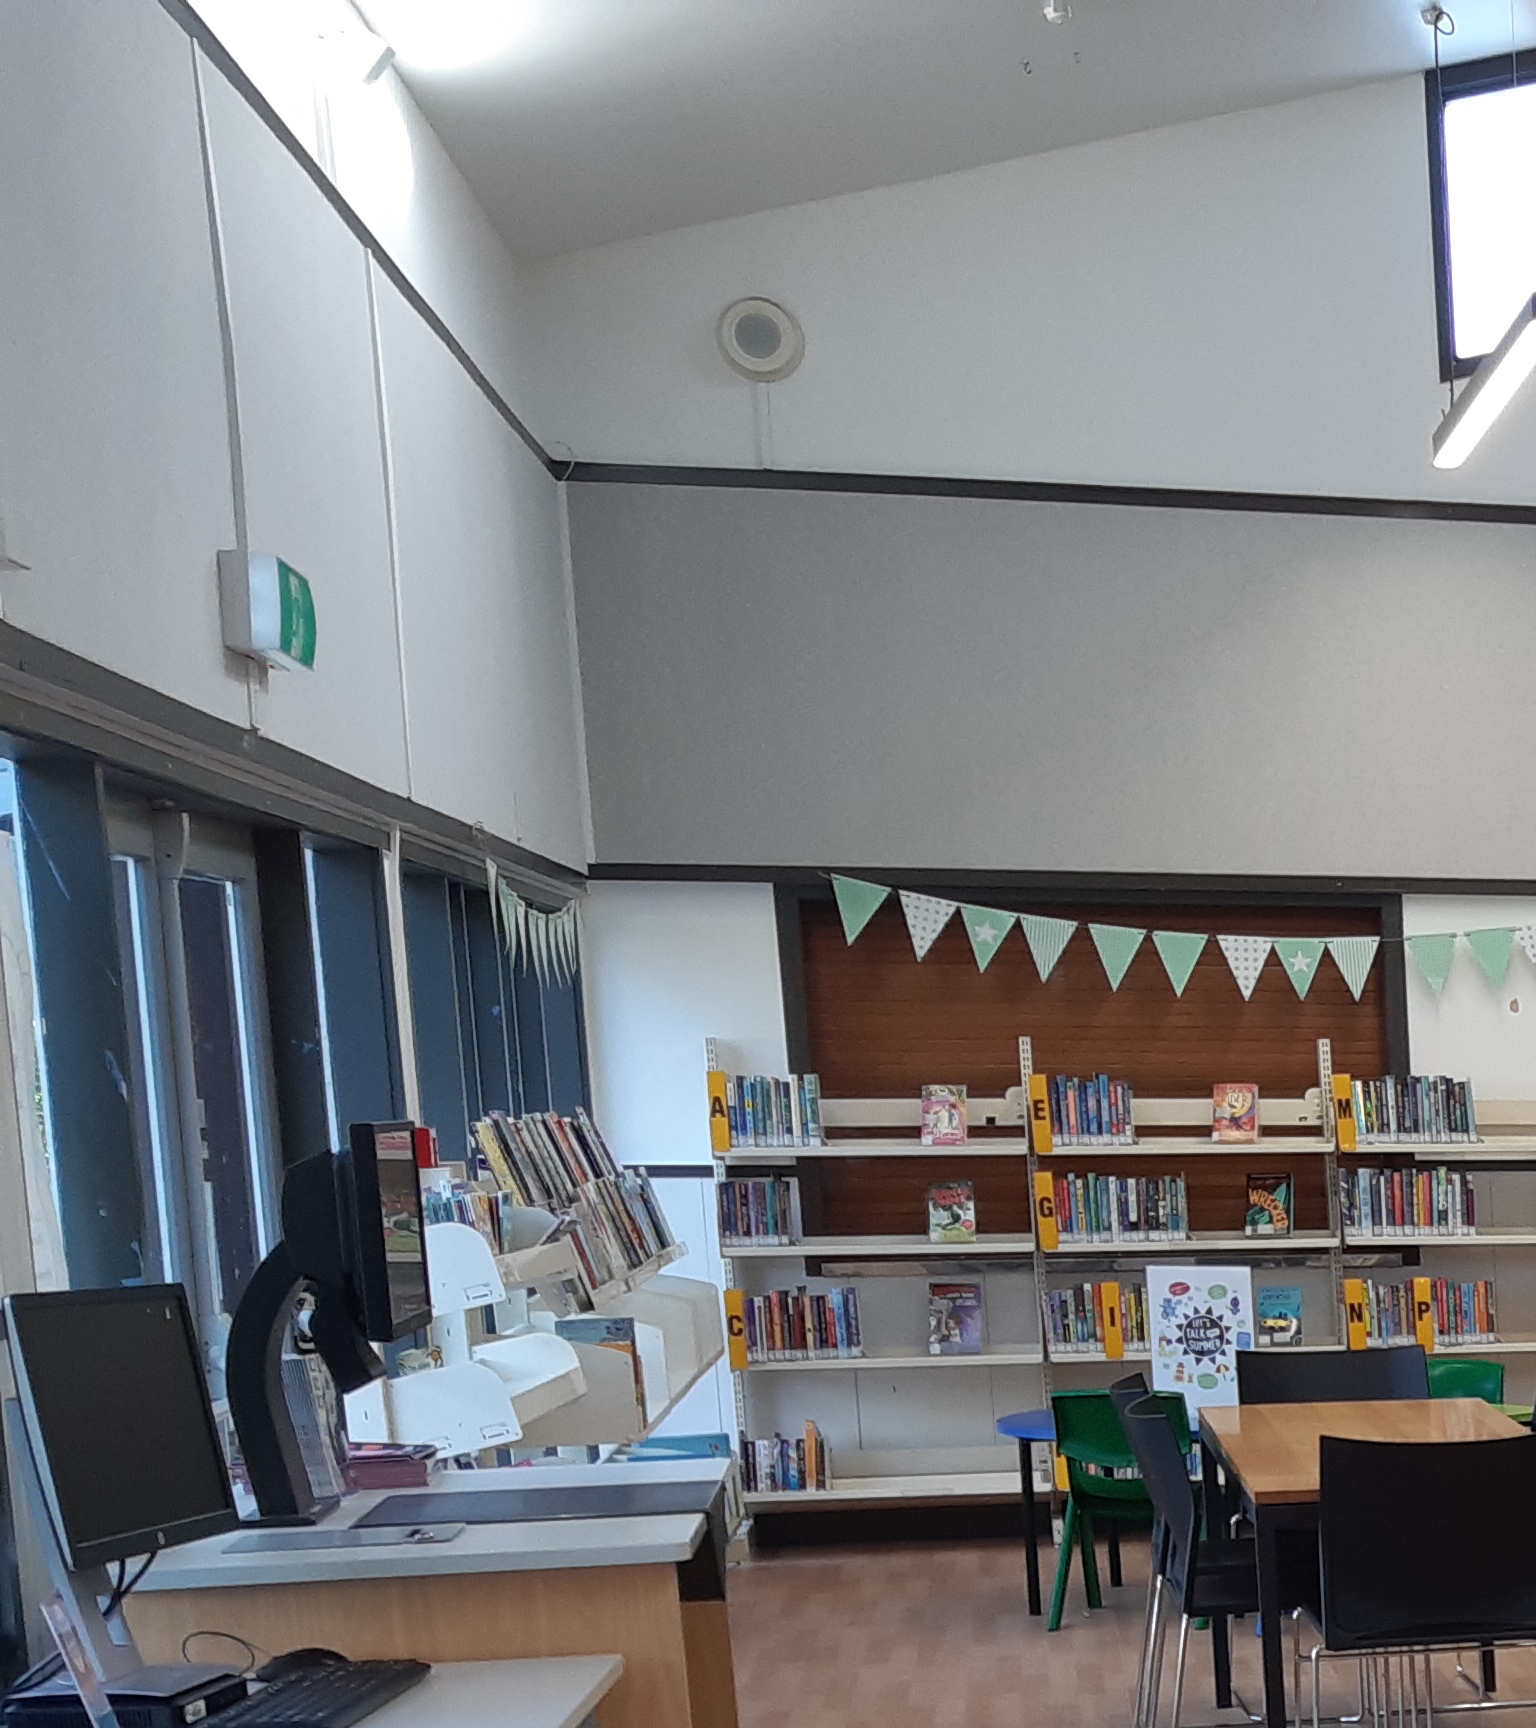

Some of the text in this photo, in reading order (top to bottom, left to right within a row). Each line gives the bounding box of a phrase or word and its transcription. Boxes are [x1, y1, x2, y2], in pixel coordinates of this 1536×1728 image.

[710, 1096, 726, 1118] A
[1033, 1100, 1046, 1120] E
[1336, 1098, 1353, 1119] M
[1038, 1195, 1053, 1219] G
[1349, 1302, 1363, 1324] N
[1416, 1300, 1430, 1321] P
[728, 1314, 743, 1336] C
[1186, 1327, 1205, 1339] TALK
[1188, 1338, 1221, 1351] SUMMER
